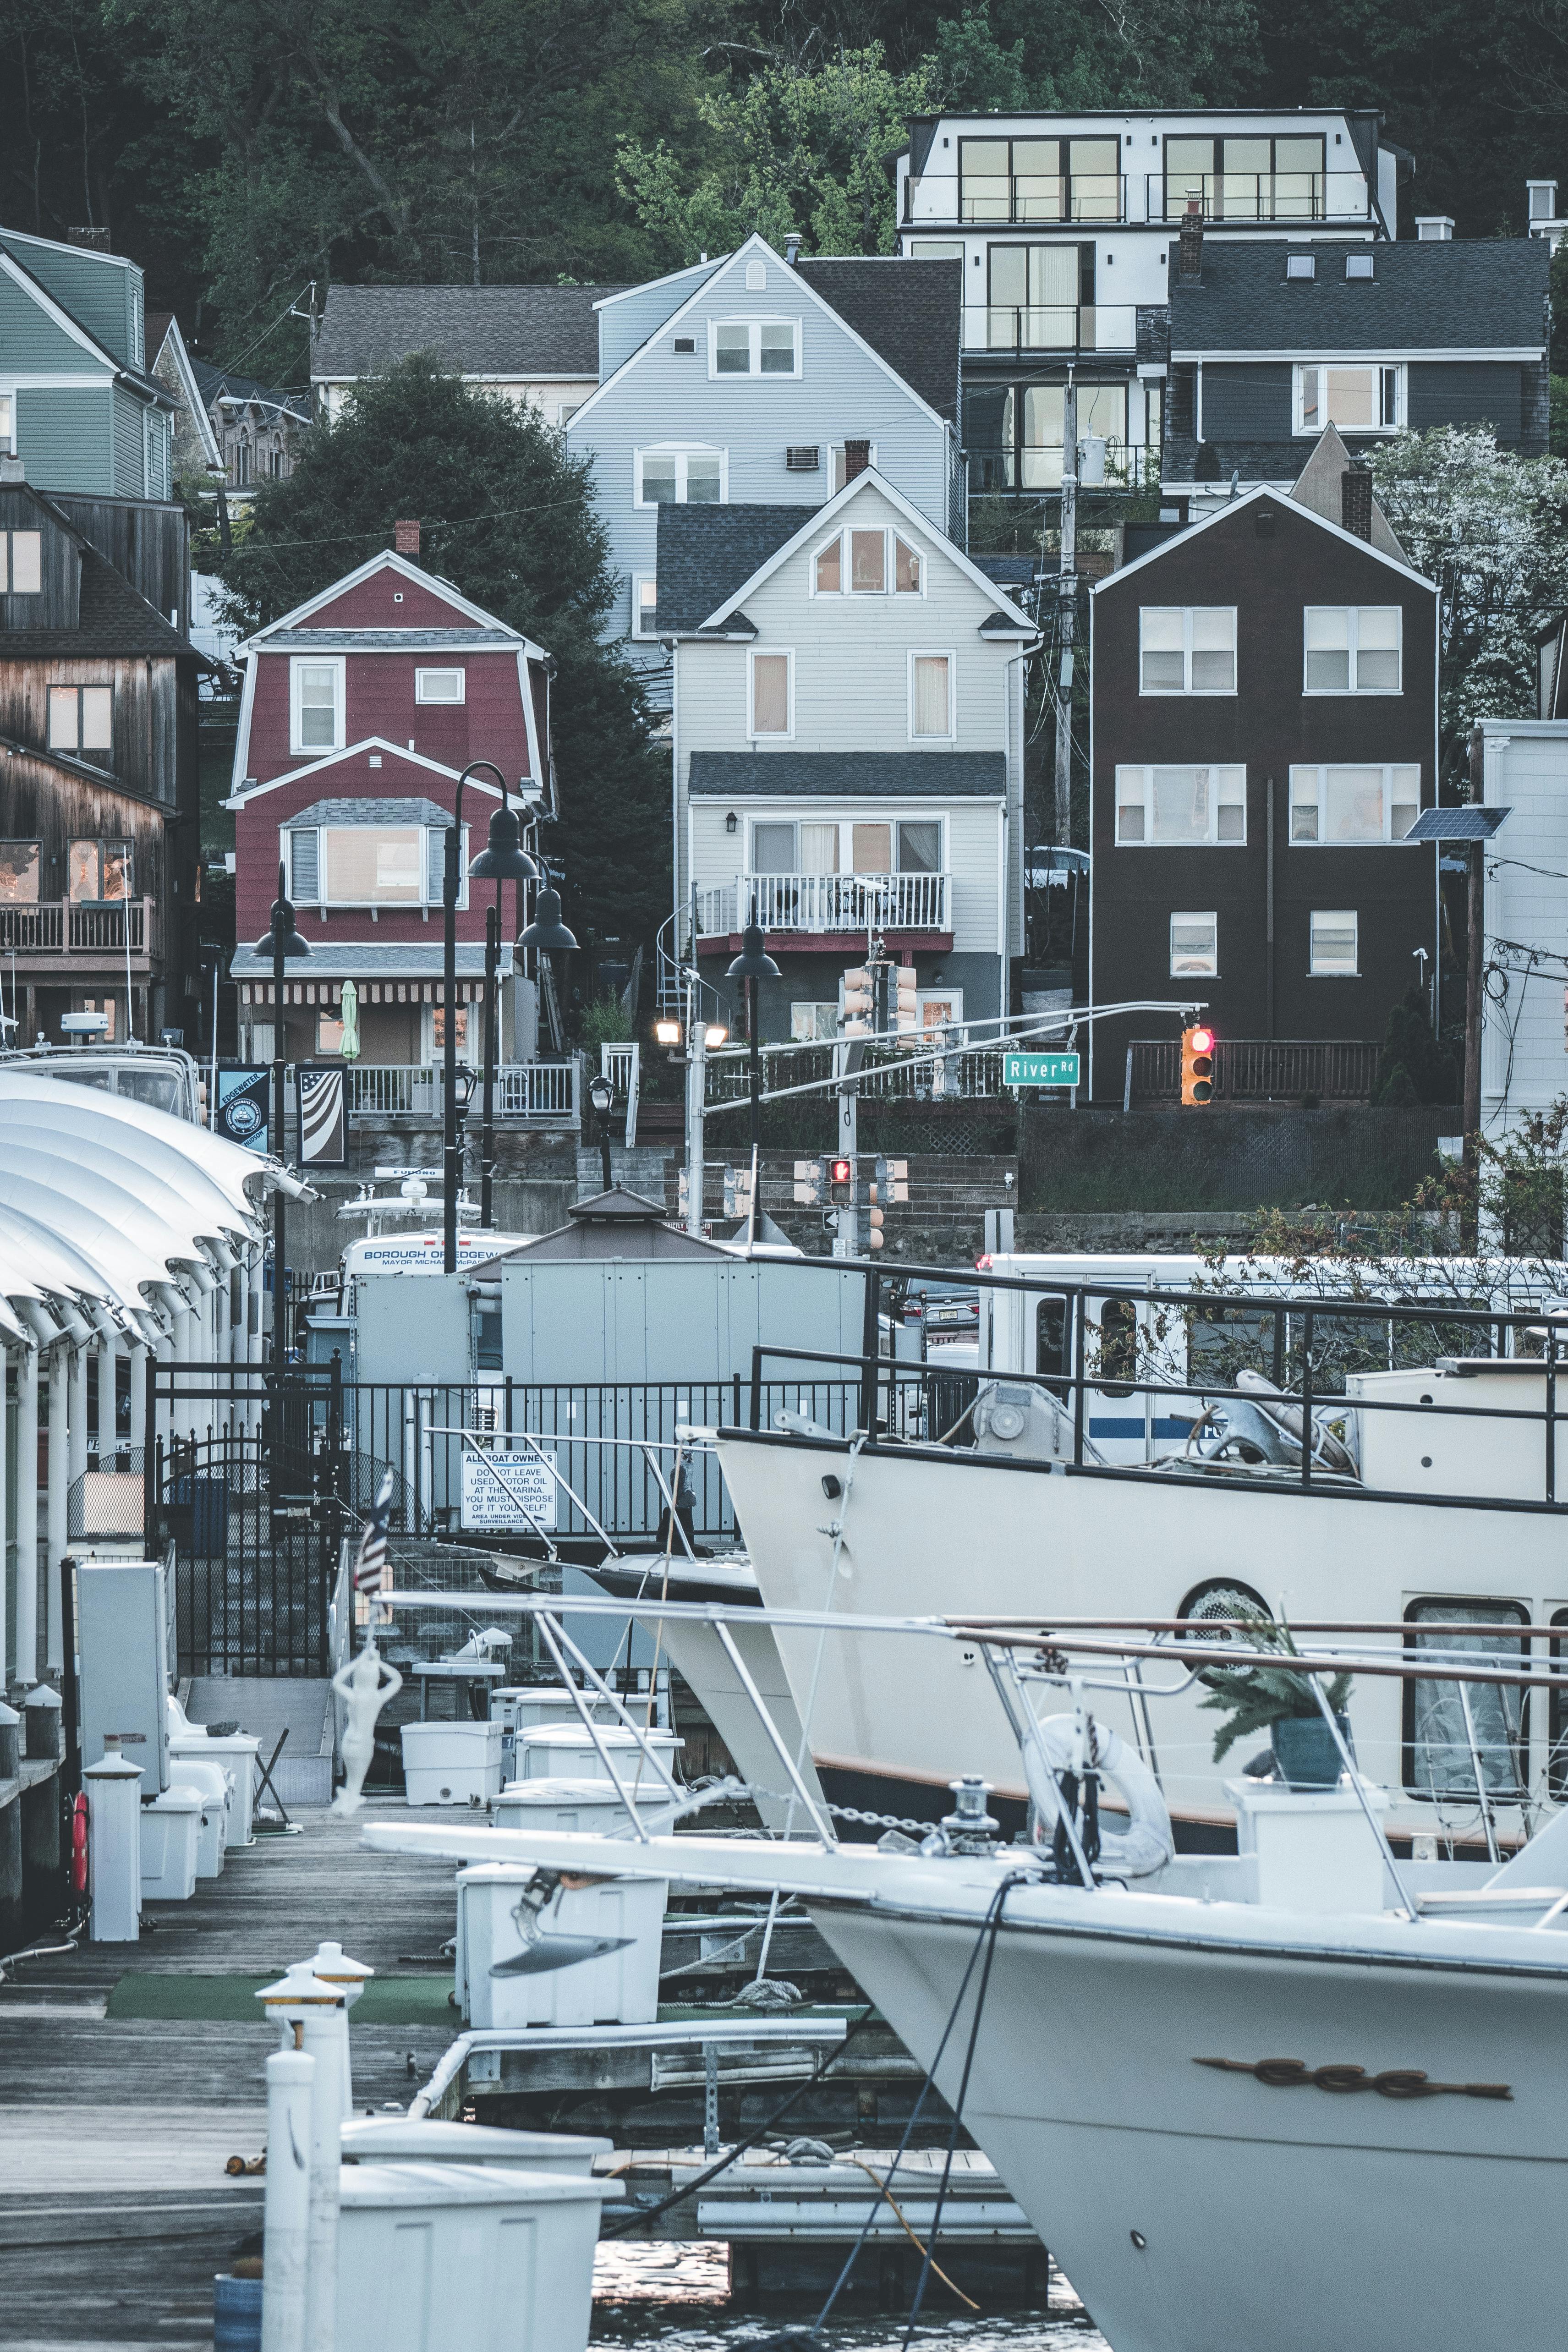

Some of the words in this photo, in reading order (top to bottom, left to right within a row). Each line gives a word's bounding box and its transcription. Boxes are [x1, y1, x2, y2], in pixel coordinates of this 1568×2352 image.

[1011, 1061, 1057, 1077] River
[1061, 1061, 1073, 1072] Rd
[222, 1073, 260, 1104] EDGEWATER
[244, 1130, 264, 1147] HUDSON
[364, 1251, 425, 1259] BOROUGH
[507, 1737, 511, 1747] 1
